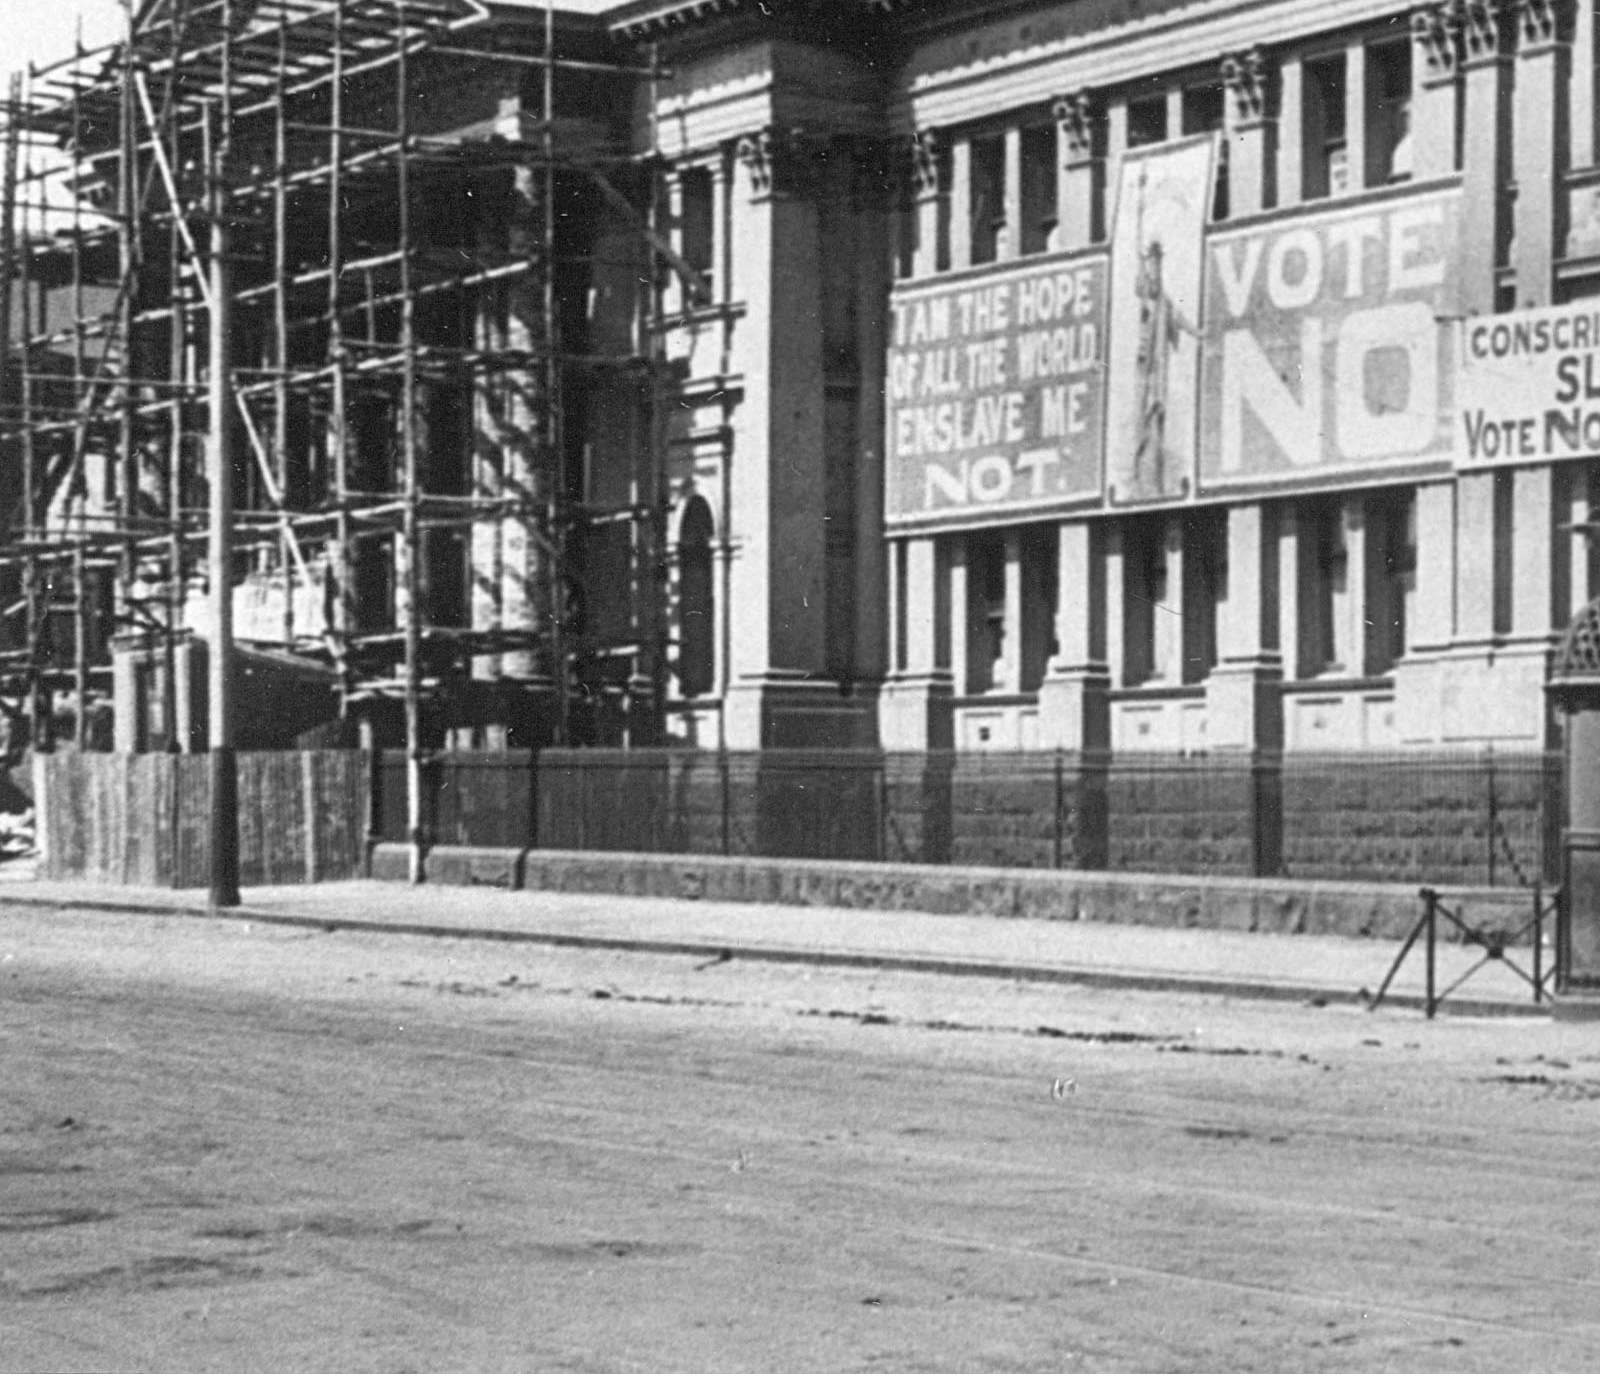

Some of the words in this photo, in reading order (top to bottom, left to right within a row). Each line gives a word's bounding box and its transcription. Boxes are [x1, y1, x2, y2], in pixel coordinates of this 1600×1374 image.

[1213, 203, 1448, 318] VOTE
[911, 297, 949, 345] AM
[958, 284, 1009, 336] THE
[1018, 271, 1093, 326] HOPE
[890, 352, 919, 400] OF
[921, 347, 960, 396] ALL
[966, 337, 1008, 391] THE
[1017, 323, 1097, 380] WORLD
[1222, 301, 1438, 475] NO
[898, 392, 1025, 456] ENSLAVE
[1042, 382, 1088, 438] ME
[1463, 409, 1536, 459] VOTE
